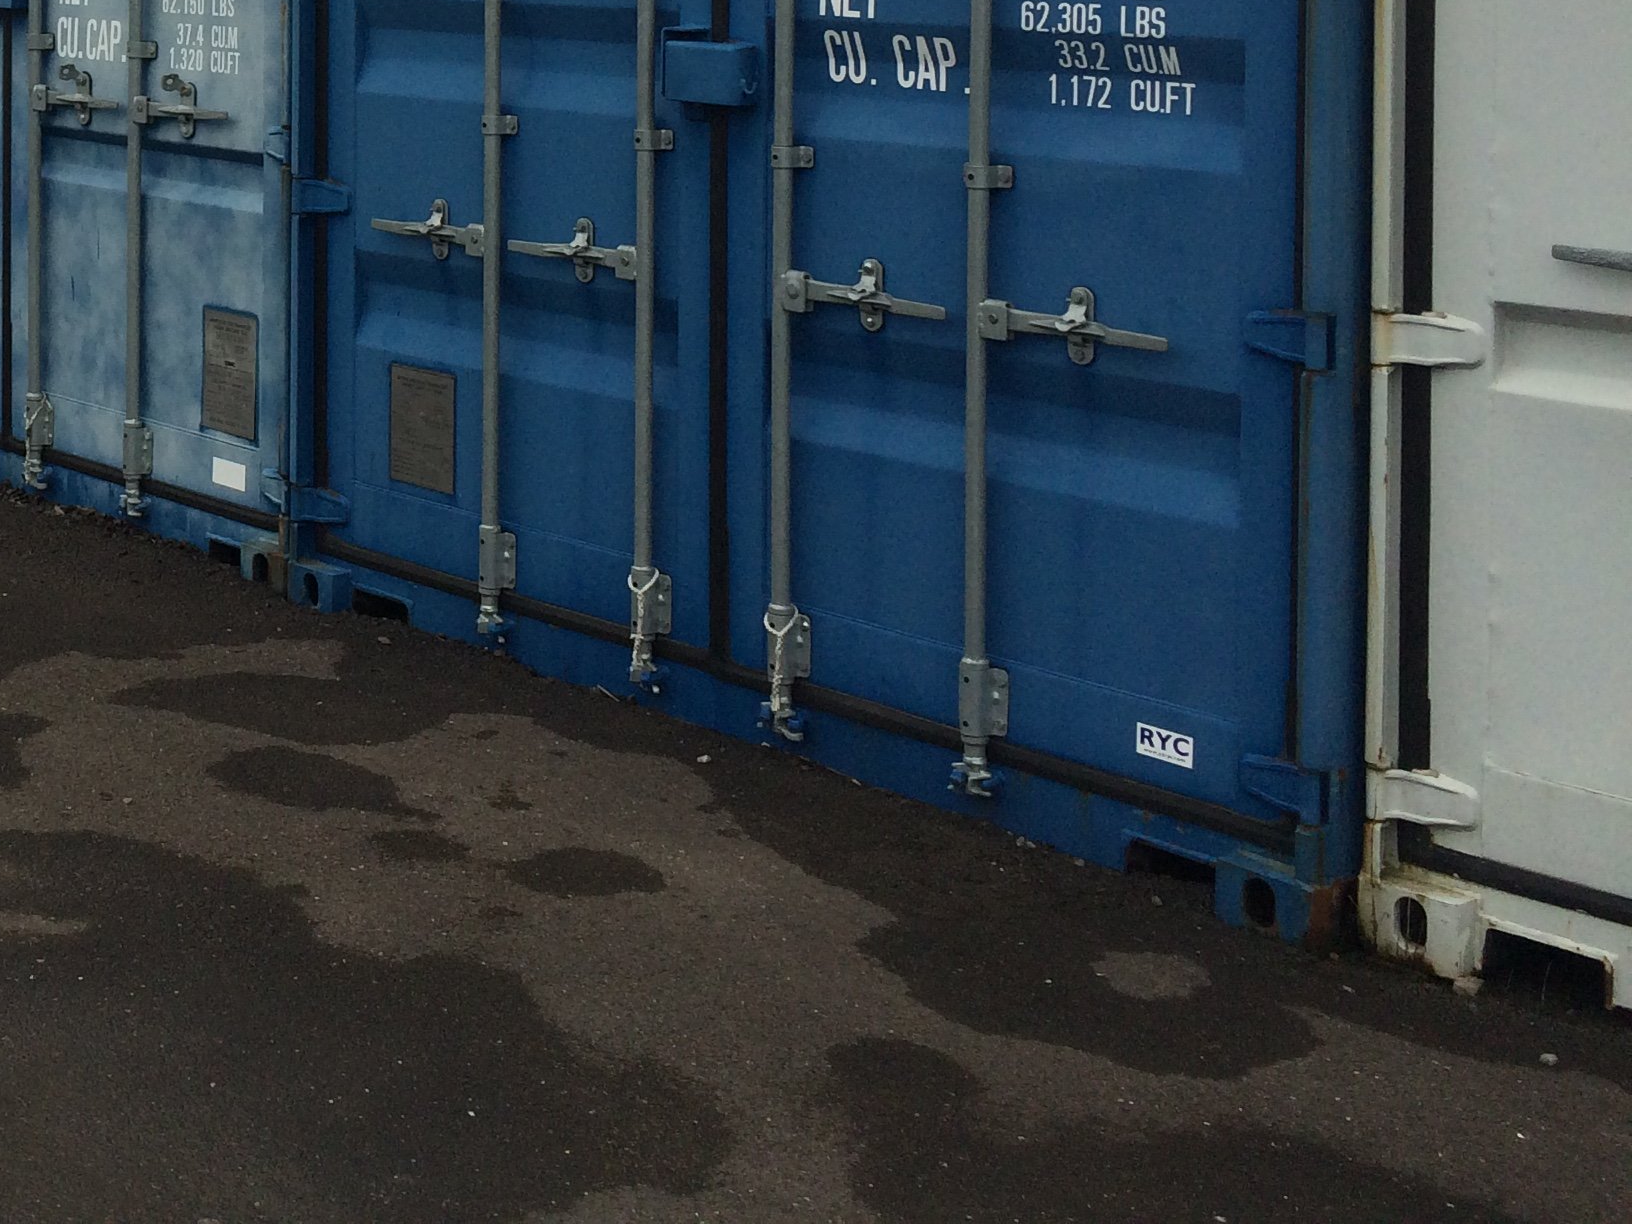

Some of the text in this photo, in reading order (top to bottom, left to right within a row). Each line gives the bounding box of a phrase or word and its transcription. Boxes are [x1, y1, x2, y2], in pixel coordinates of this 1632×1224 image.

[176, 23, 238, 49] 37.4 CU.M
[1120, 5, 1165, 39] LBS
[170, 47, 240, 75] 1.320 CU.FT
[823, 29, 877, 85] CU.
[1054, 39, 1181, 75] 33.2 CU.M
[1130, 79, 1196, 115] CU.FT
[1140, 727, 1190, 757] RYC
